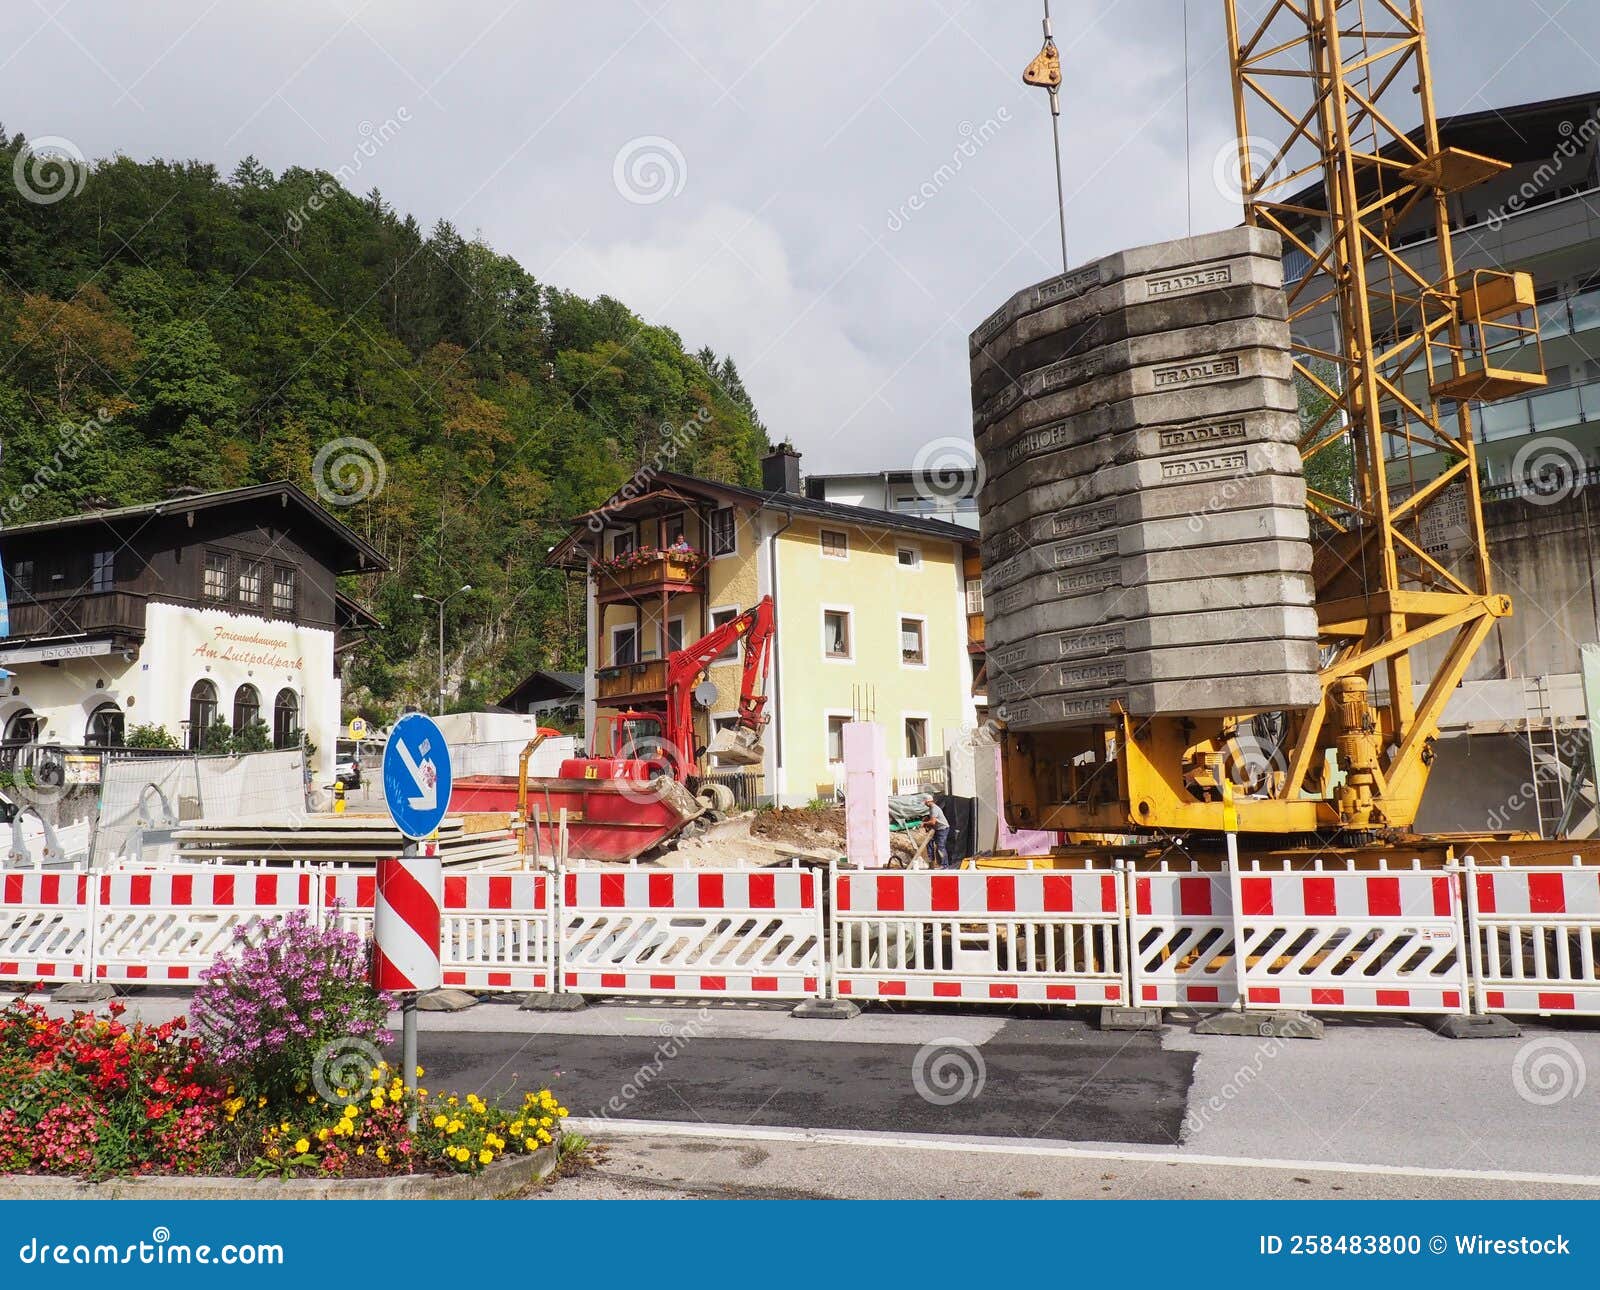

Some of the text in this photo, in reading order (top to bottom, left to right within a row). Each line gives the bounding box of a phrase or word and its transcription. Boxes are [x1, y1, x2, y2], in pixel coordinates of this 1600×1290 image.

[1150, 270, 1227, 293] TRADLER
[1157, 361, 1235, 383] TRADLER
[1162, 423, 1241, 445] TRADLER
[1164, 455, 1244, 476] TRADLER
[213, 626, 289, 650] Ferienwohnungen
[192, 642, 304, 671] Am Luitpoldpark
